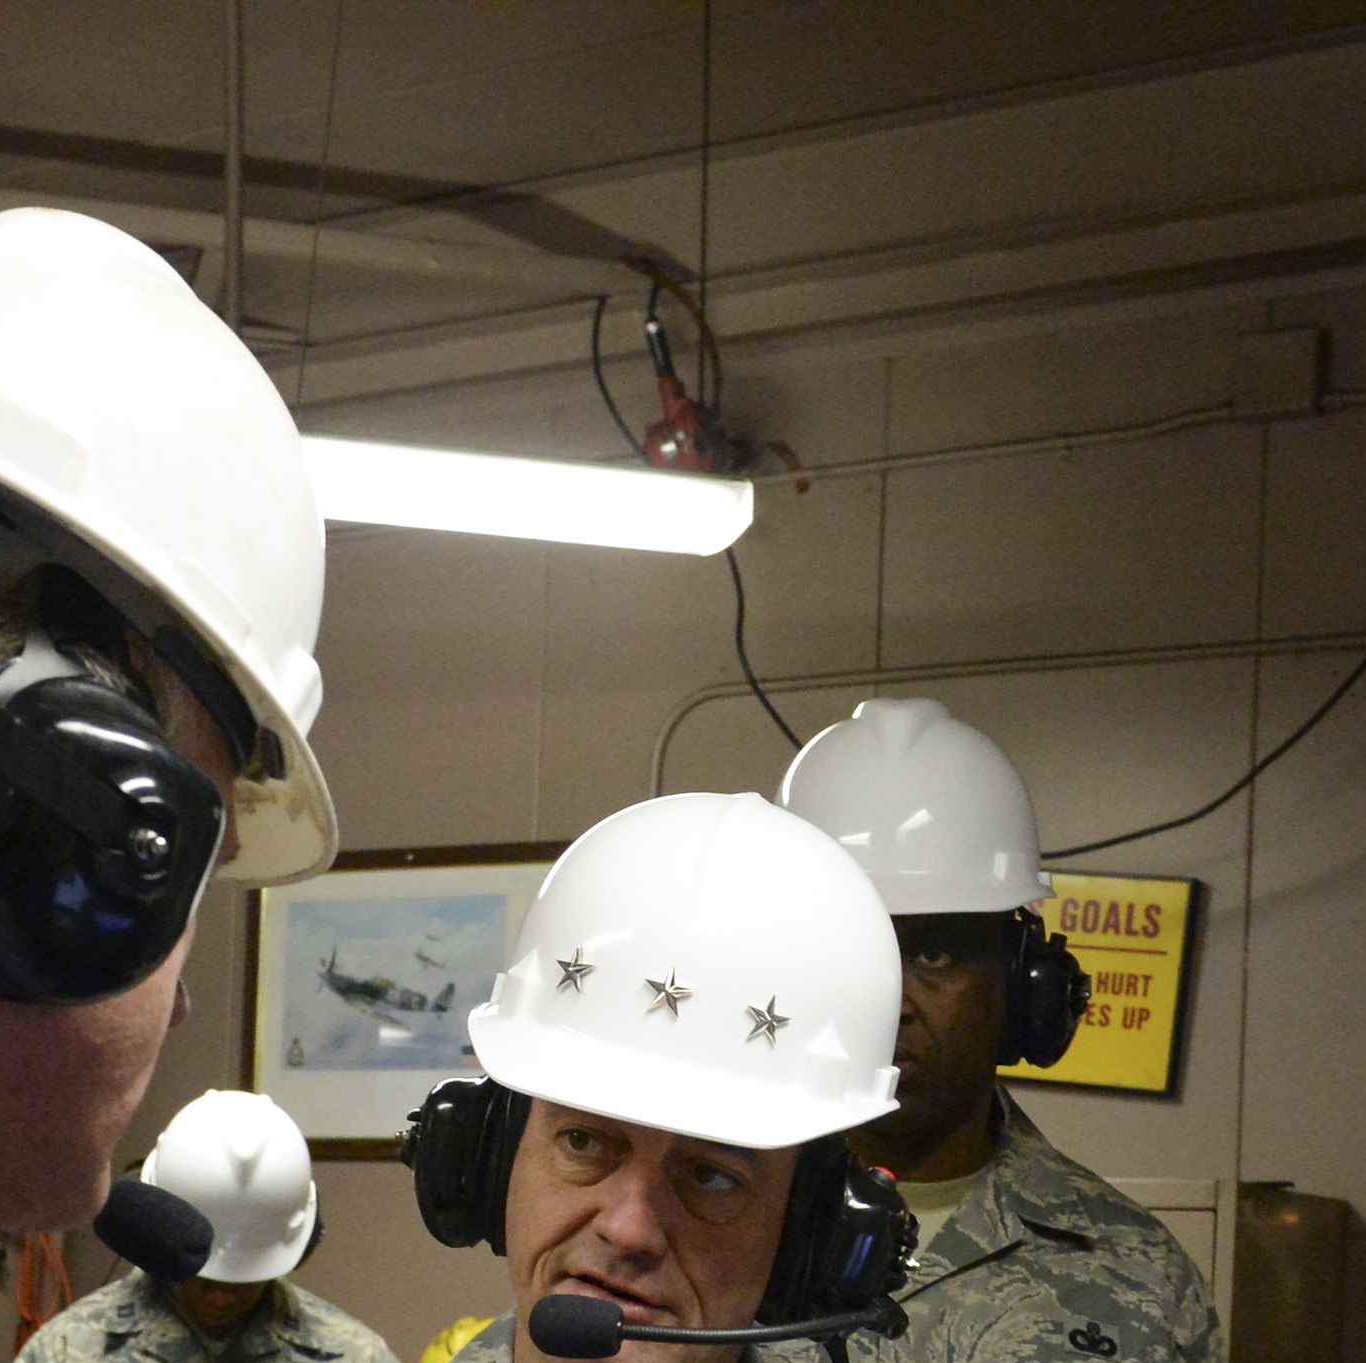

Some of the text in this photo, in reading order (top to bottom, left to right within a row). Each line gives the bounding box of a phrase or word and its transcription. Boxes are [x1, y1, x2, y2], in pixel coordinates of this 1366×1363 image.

[1060, 897, 1163, 938] GOALS
[1096, 970, 1154, 998] HURT
[1084, 1002, 1151, 1030] ES UP
